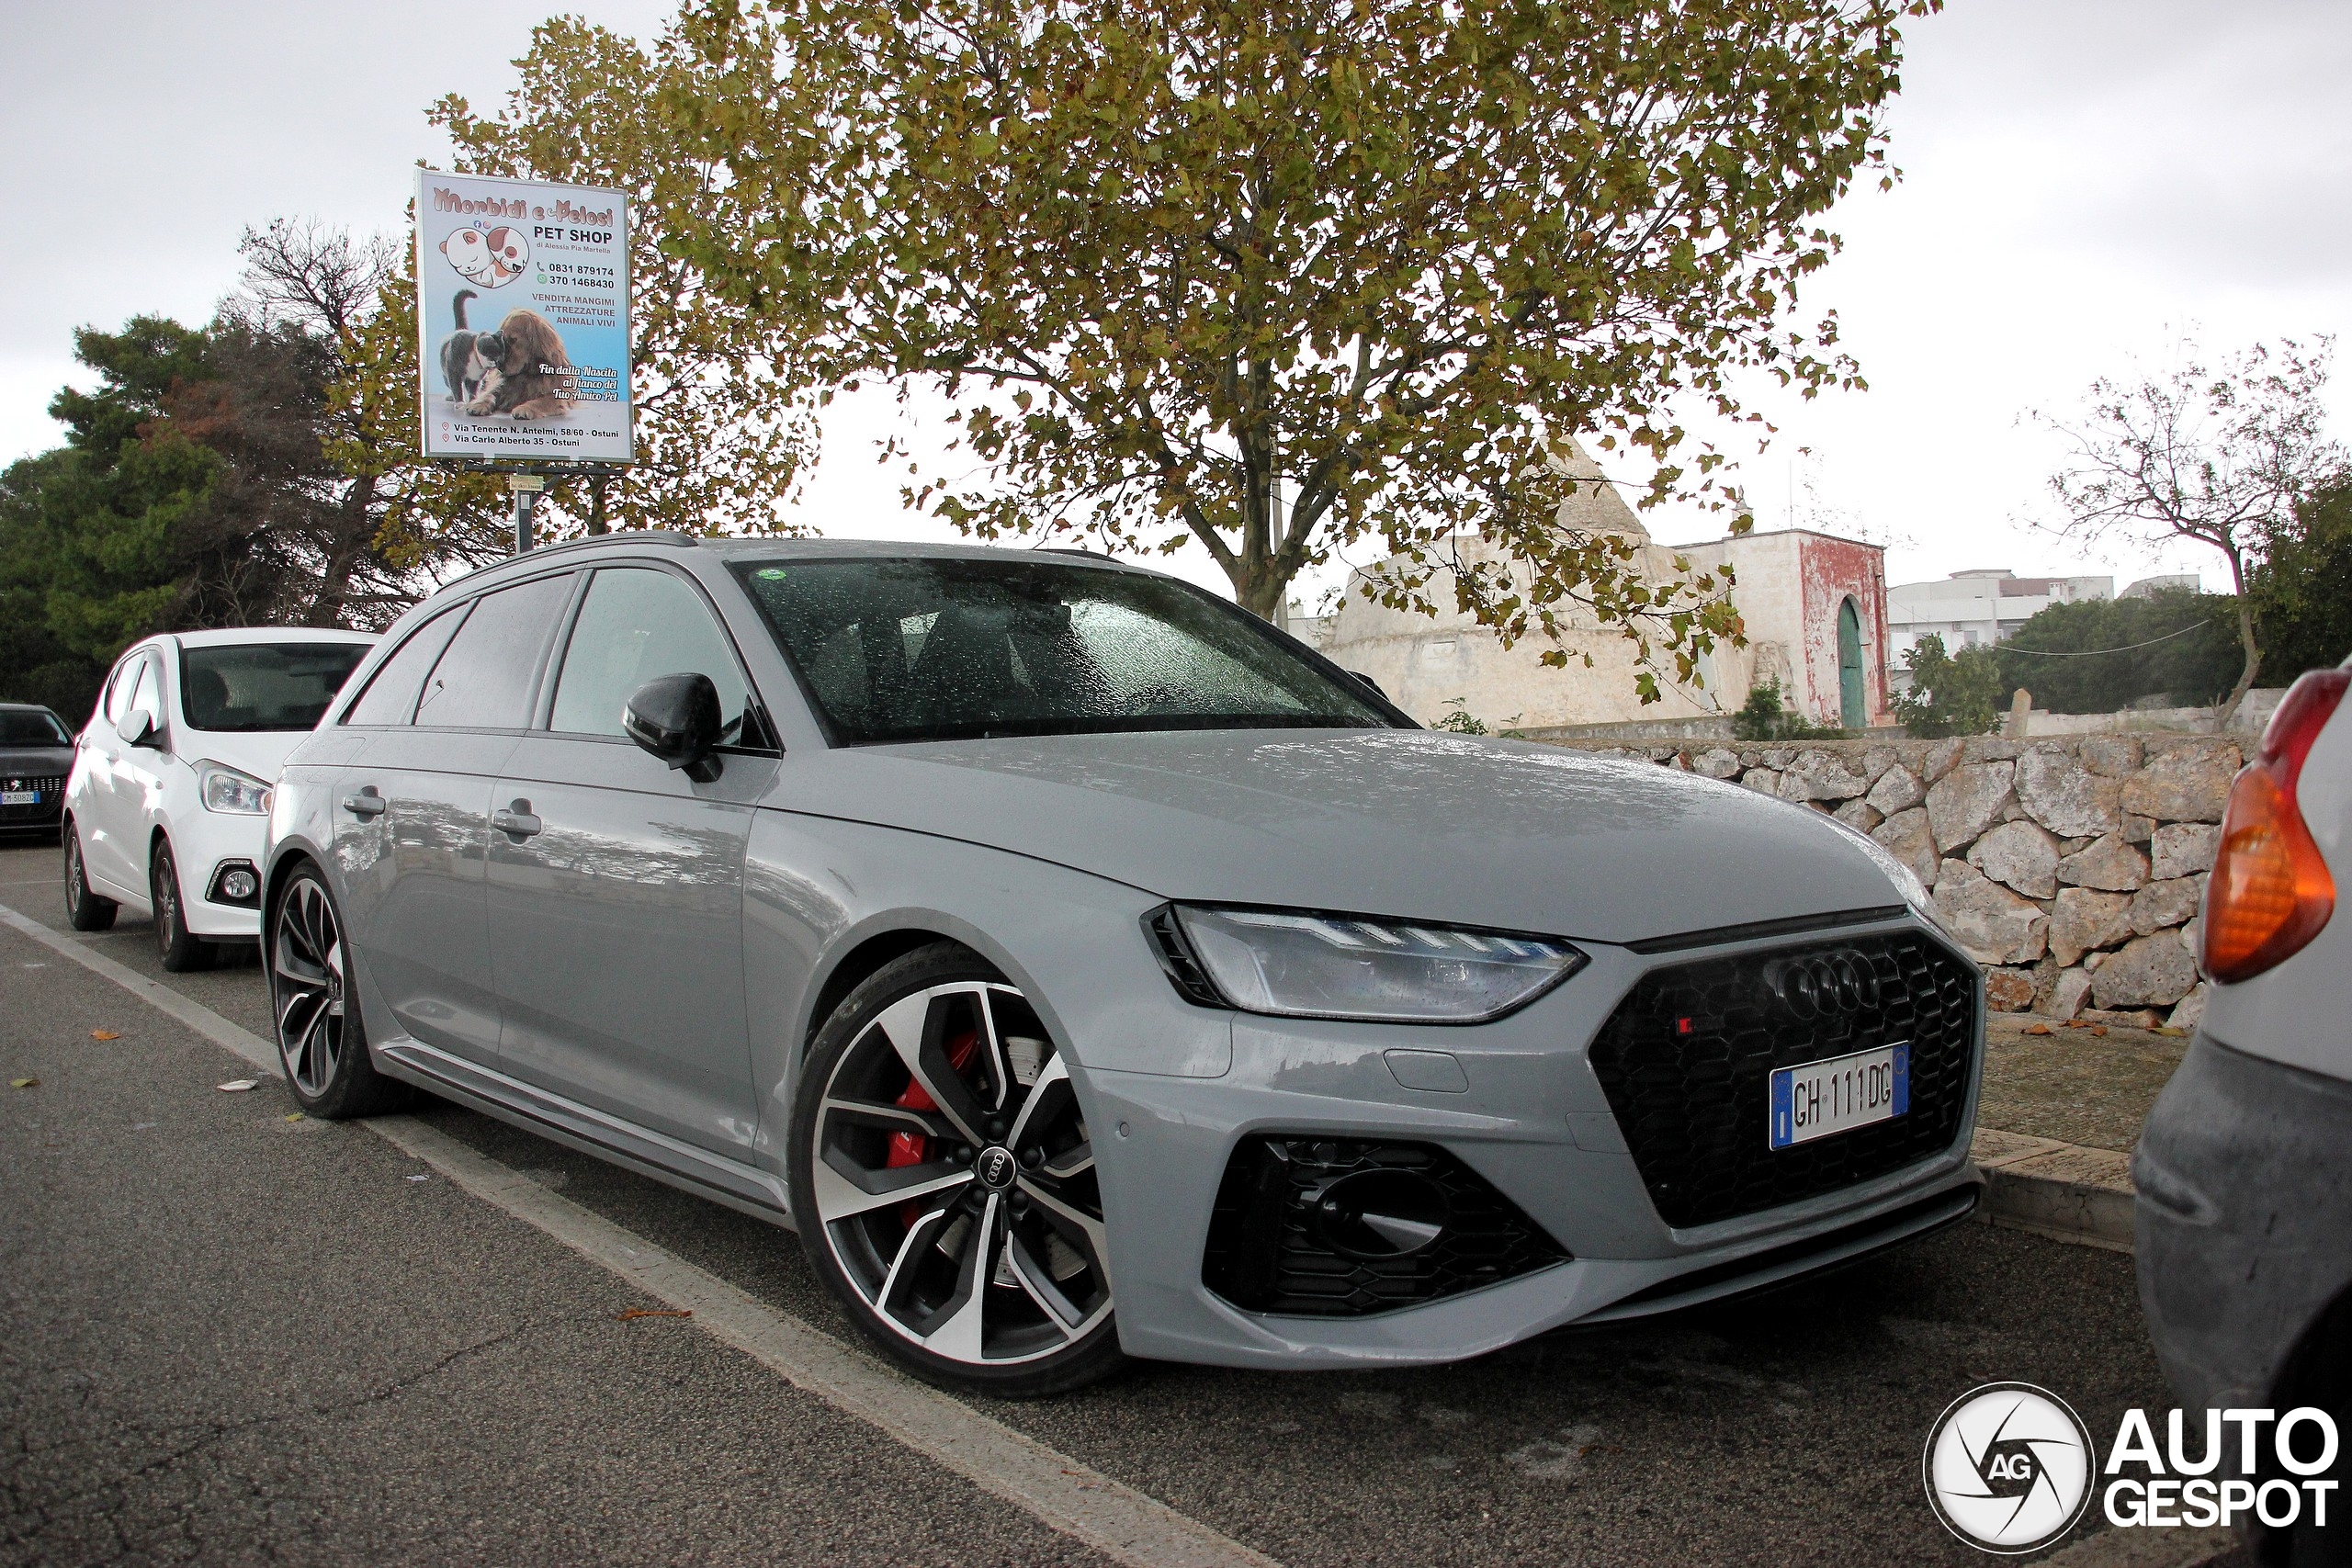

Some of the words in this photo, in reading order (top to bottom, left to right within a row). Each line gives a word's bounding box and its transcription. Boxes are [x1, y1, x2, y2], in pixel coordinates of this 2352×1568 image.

[433, 186, 526, 220] Morbidi
[532, 206, 545, 220] e
[547, 199, 614, 228] Pelosi
[534, 226, 564, 240] PET
[570, 230, 613, 244] SHOP
[545, 243, 570, 251] Alessia
[583, 246, 611, 254] Martella
[548, 263, 573, 273] 0831
[577, 265, 614, 276] 879174
[549, 276, 568, 285] 370
[571, 277, 615, 288] 1468430
[532, 293, 572, 303] VENDITA
[574, 297, 615, 306] MANGIMI
[545, 305, 616, 317] ATTREZZATURE
[557, 316, 594, 326] ANIMALI
[597, 319, 616, 327] VIVI
[539, 363, 555, 375] Fin
[556, 365, 581, 376] dalla
[582, 366, 617, 378] Nascita
[562, 378, 572, 388] al
[572, 378, 603, 390] fianco
[604, 379, 617, 389] del
[552, 388, 571, 400] Tuo
[571, 389, 602, 401] Amico
[603, 390, 618, 401] Pet
[454, 423, 469, 432] Via
[471, 425, 507, 434] Tenente
[522, 427, 559, 436] Antelmi,
[560, 428, 583, 436] 58/60
[591, 429, 619, 438] Ostuni
[454, 434, 469, 443] Via
[471, 435, 495, 444] Carlo
[498, 436, 531, 445] Alberto
[533, 437, 544, 446] 35
[551, 438, 580, 446] Ostuni
[1793, 1077, 1821, 1127] GH
[1830, 1061, 1892, 1119] 111DG
